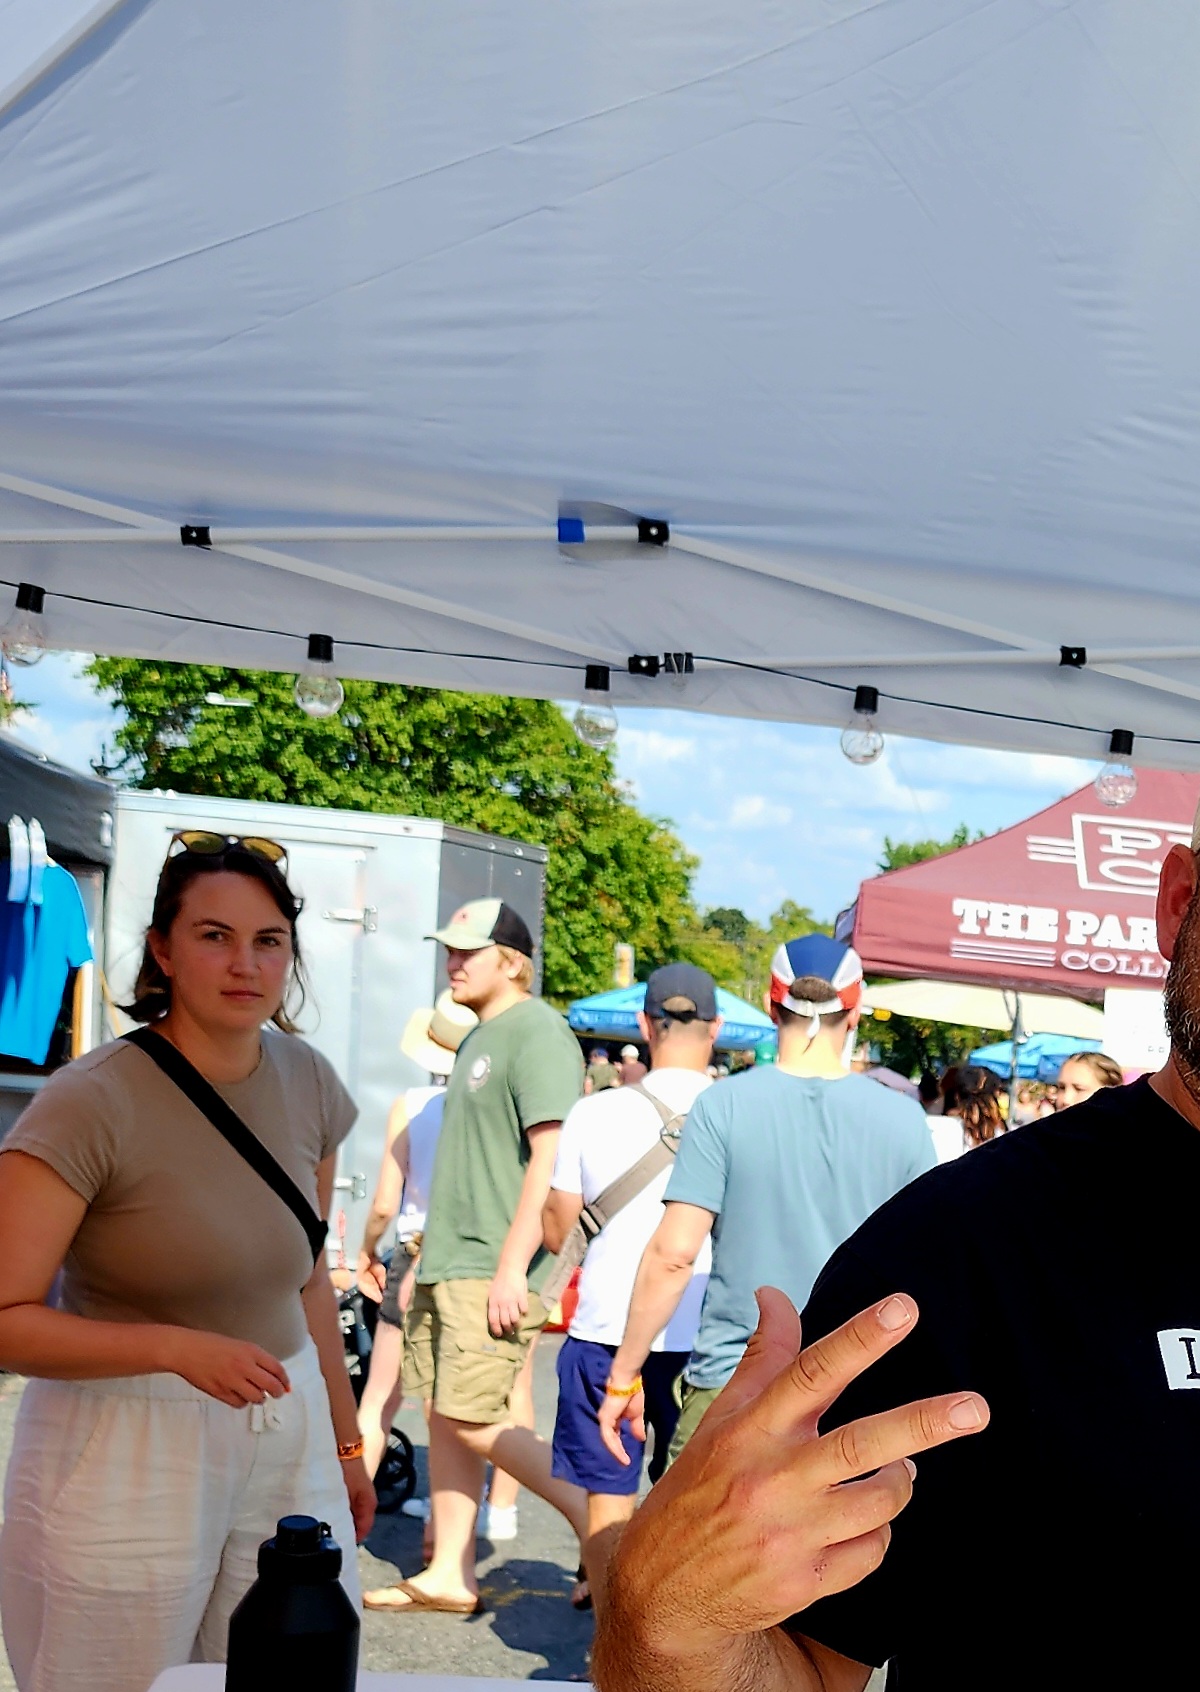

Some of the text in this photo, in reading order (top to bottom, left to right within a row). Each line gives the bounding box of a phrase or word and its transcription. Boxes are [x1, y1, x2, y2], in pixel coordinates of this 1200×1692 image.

[952, 899, 1158, 953] THE PAR
[1060, 950, 1169, 978] COLL
